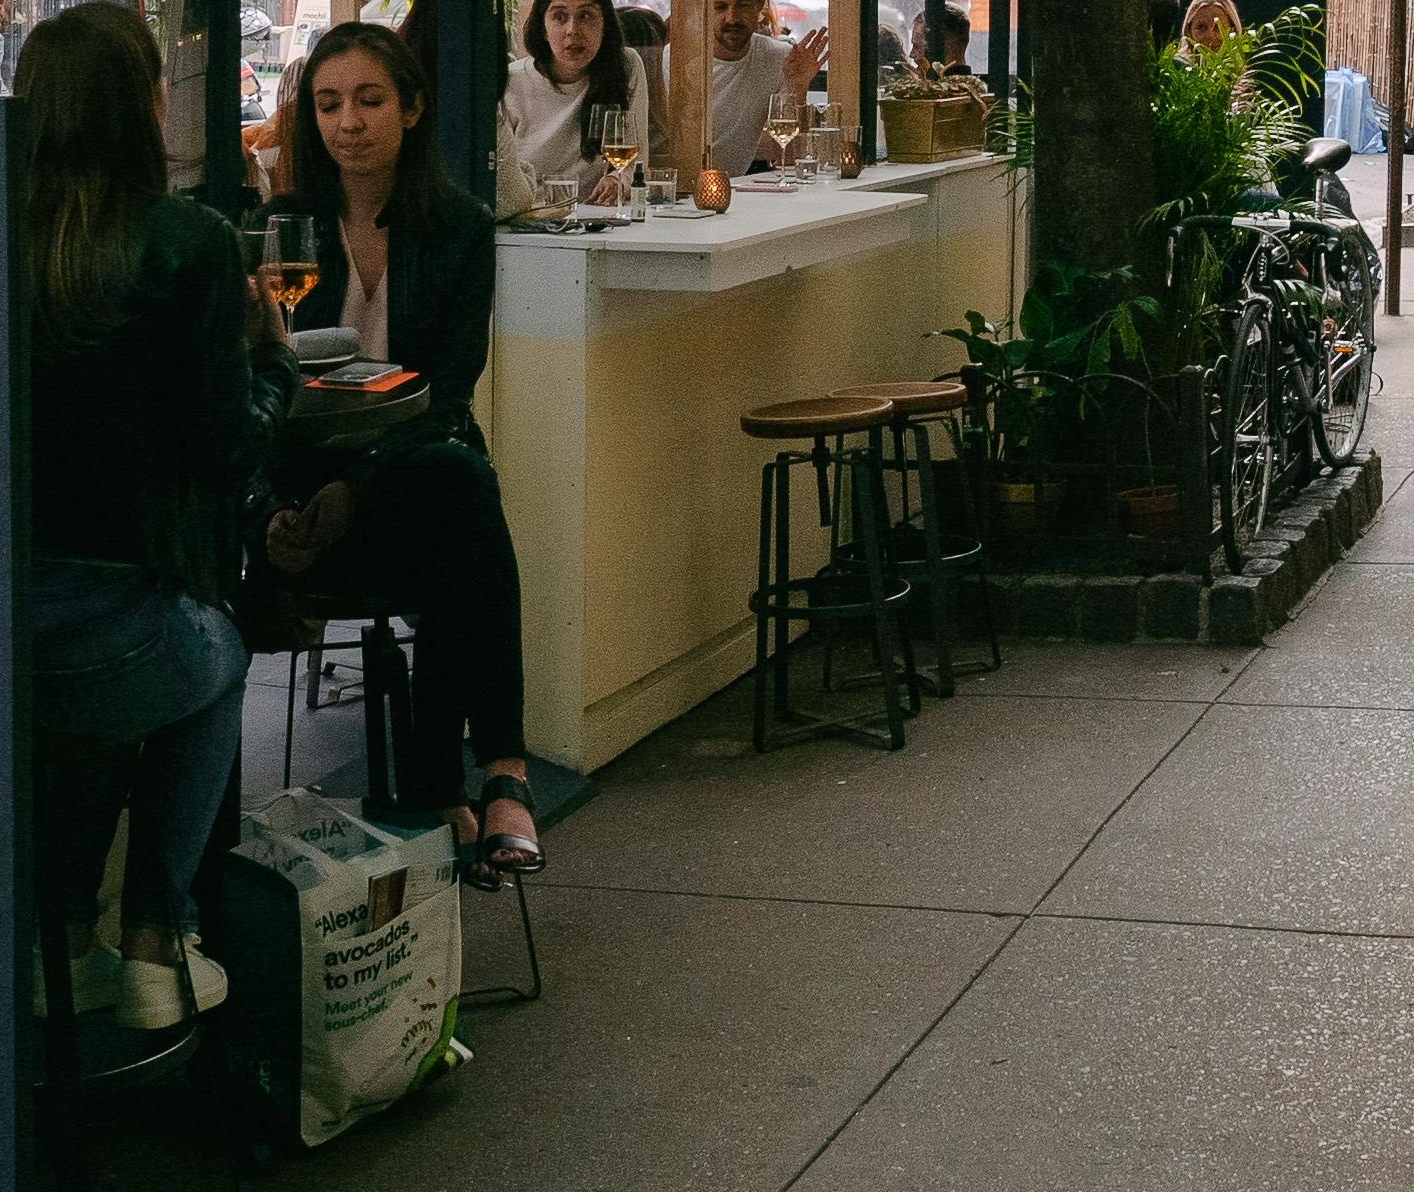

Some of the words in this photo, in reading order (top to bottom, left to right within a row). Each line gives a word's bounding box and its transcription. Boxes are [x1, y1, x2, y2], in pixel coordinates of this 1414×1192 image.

[324, 920, 411, 968] avocados
[323, 974, 349, 992] to
[353, 959, 383, 986] my
[324, 997, 362, 1016] Meet
[364, 983, 389, 1006] your
[390, 971, 413, 991] new
